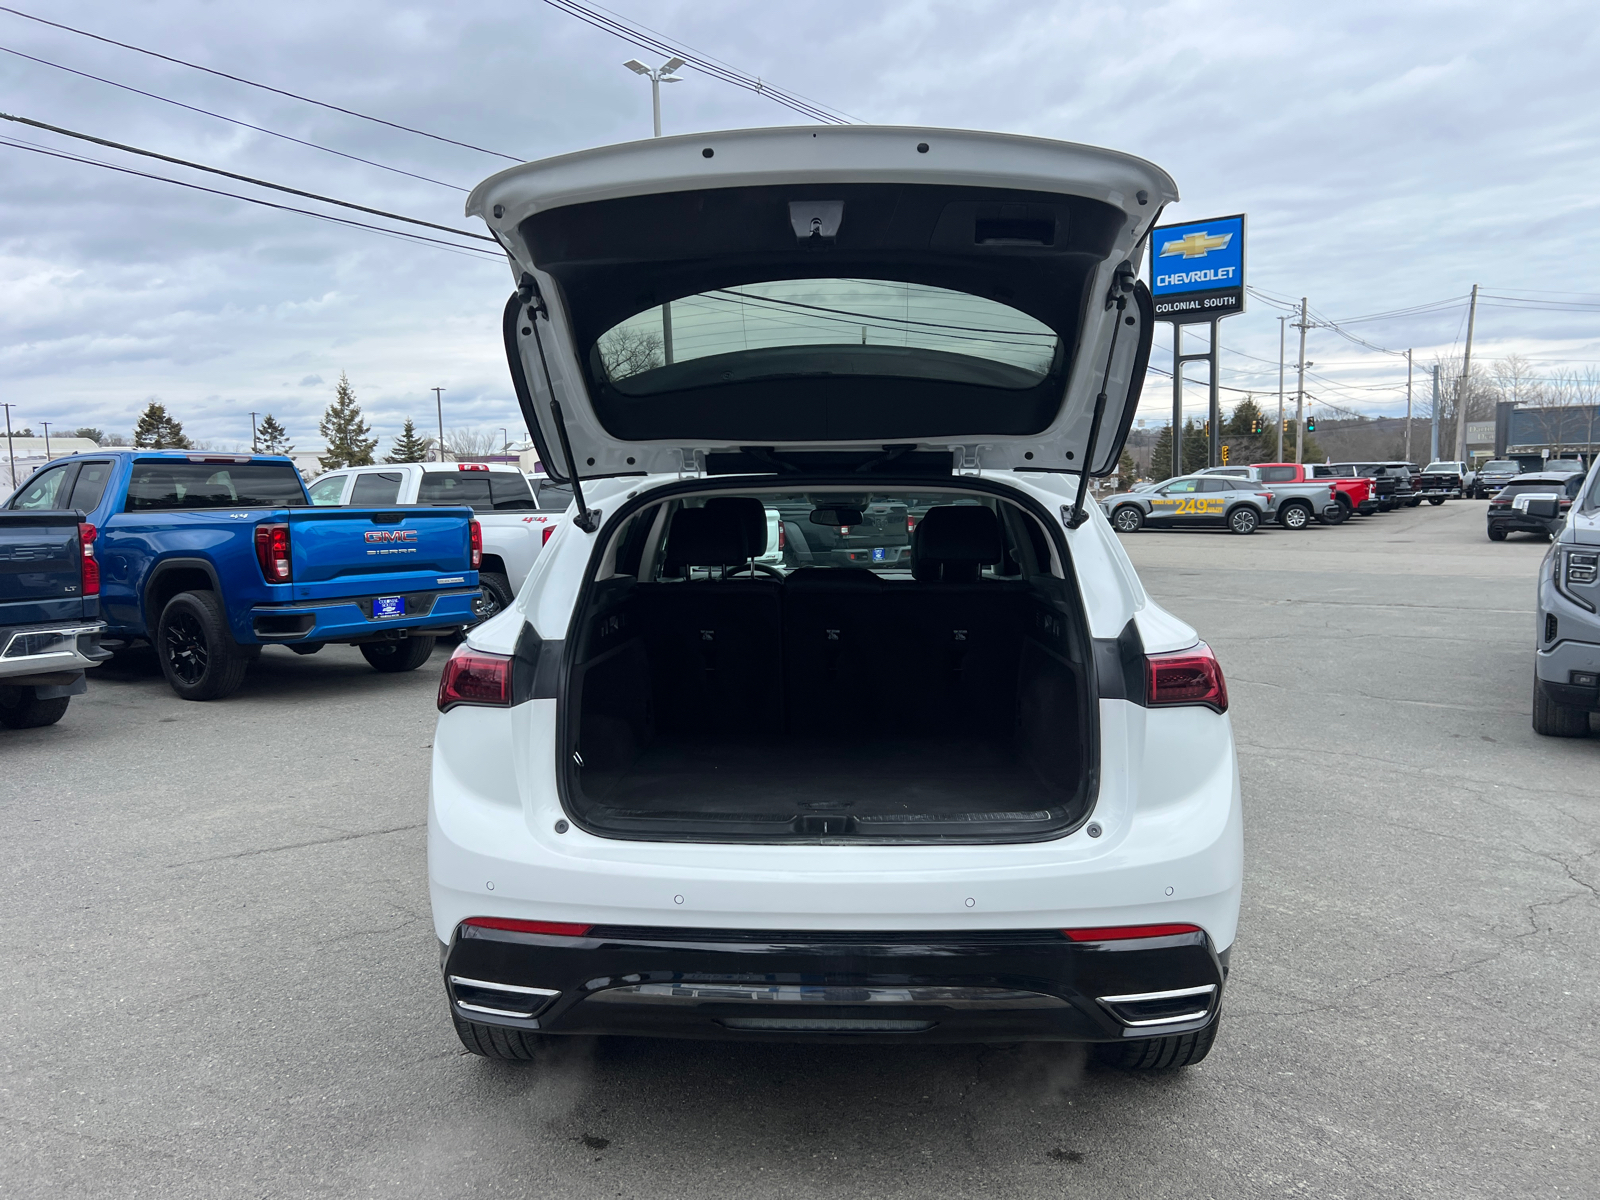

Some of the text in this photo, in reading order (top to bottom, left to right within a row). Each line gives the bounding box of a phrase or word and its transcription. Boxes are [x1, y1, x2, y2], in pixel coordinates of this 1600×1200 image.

[1156, 266, 1236, 287] CHEVROLET
[1156, 296, 1236, 313] COLONIAL SOUTH
[364, 529, 418, 544] GMC
[366, 548, 417, 556] SIERRA
